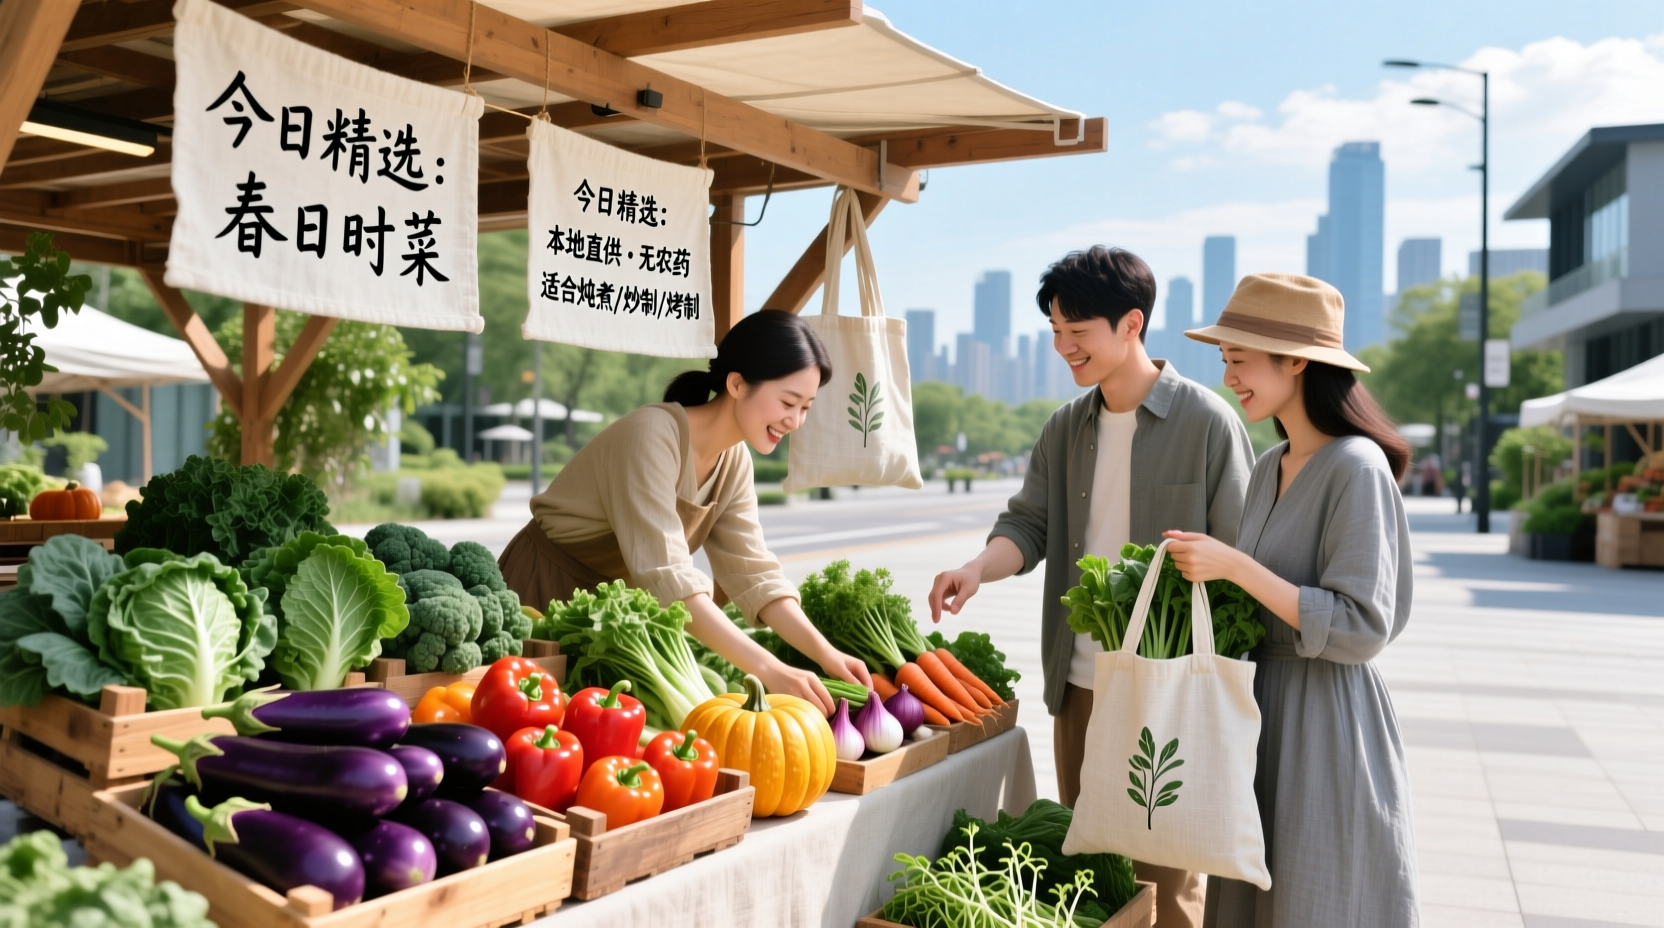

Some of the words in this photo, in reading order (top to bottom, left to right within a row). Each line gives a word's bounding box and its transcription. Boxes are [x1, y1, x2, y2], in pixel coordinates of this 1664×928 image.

[205, 70, 445, 192] 今日精选：
[215, 170, 450, 287] 春日时菜
[573, 178, 668, 228] 今日精选：
